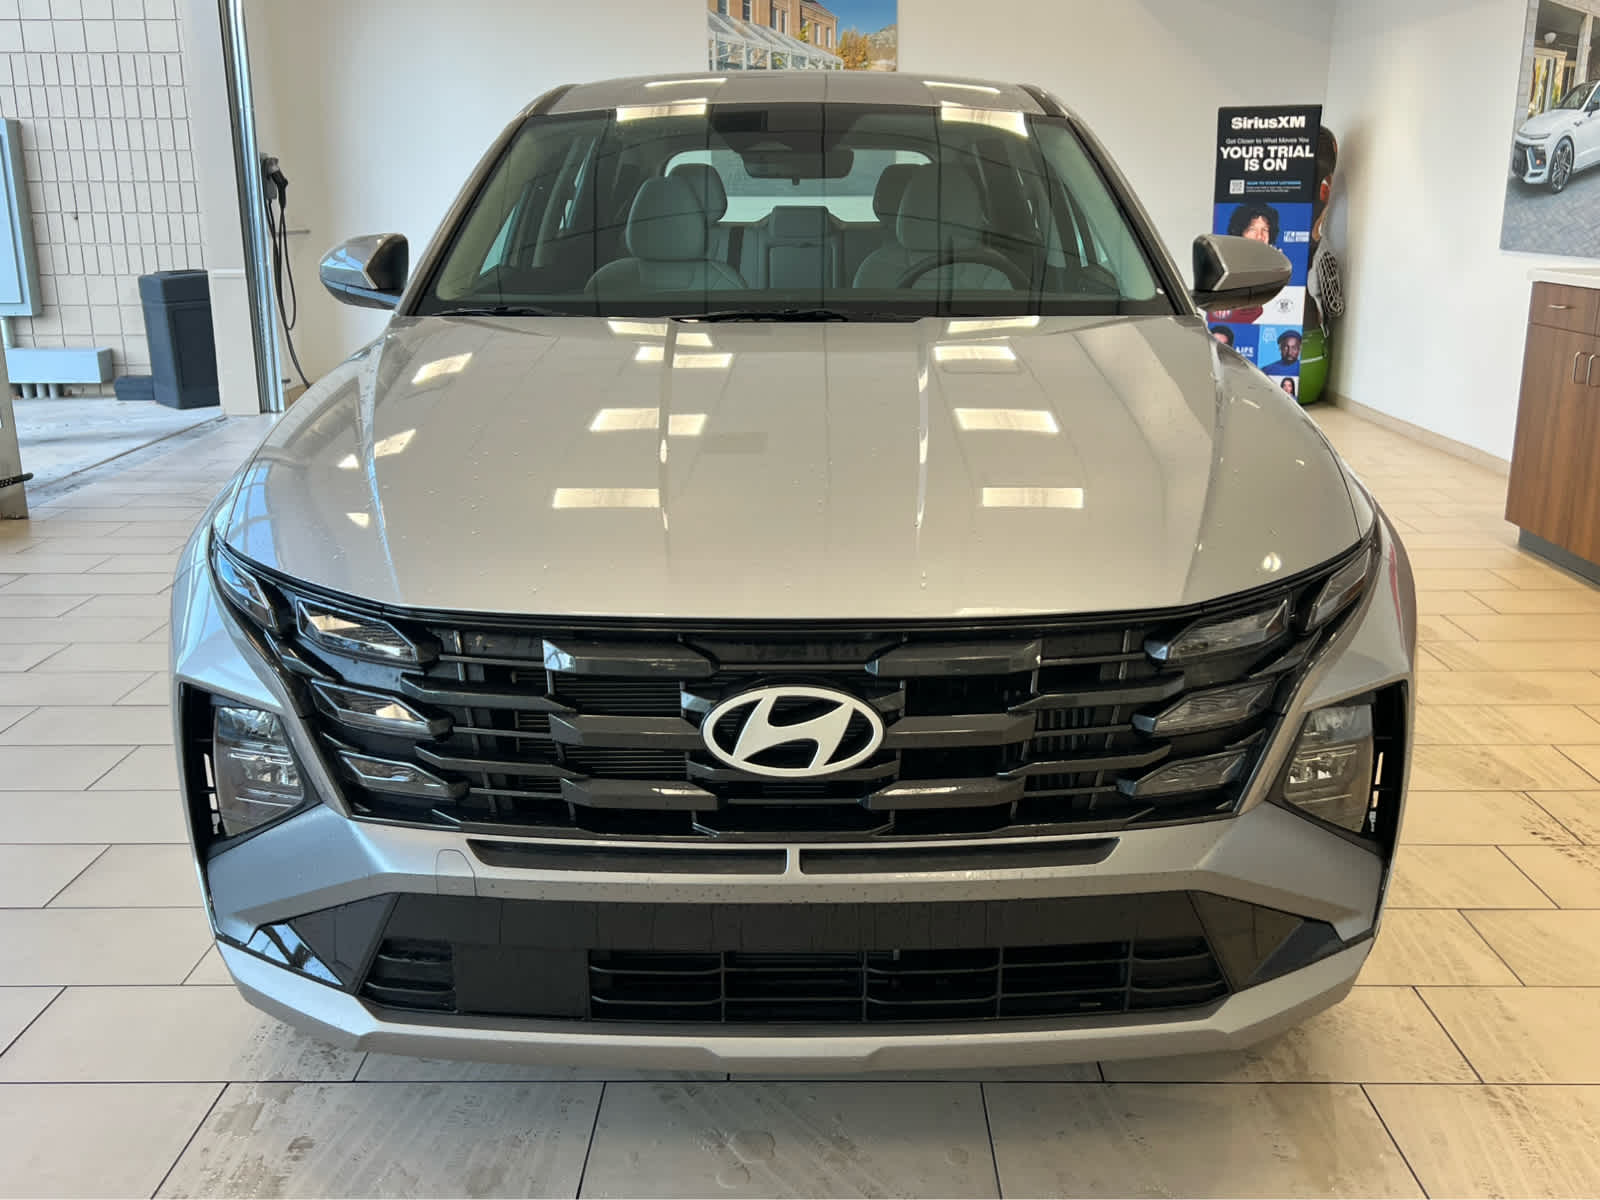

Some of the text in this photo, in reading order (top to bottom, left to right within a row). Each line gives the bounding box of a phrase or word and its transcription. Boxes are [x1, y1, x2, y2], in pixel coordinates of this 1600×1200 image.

[1231, 115, 1306, 130] SiriusXM
[1220, 144, 1315, 159] YOUR TRIAL
[1244, 158, 1288, 171] IS ON
